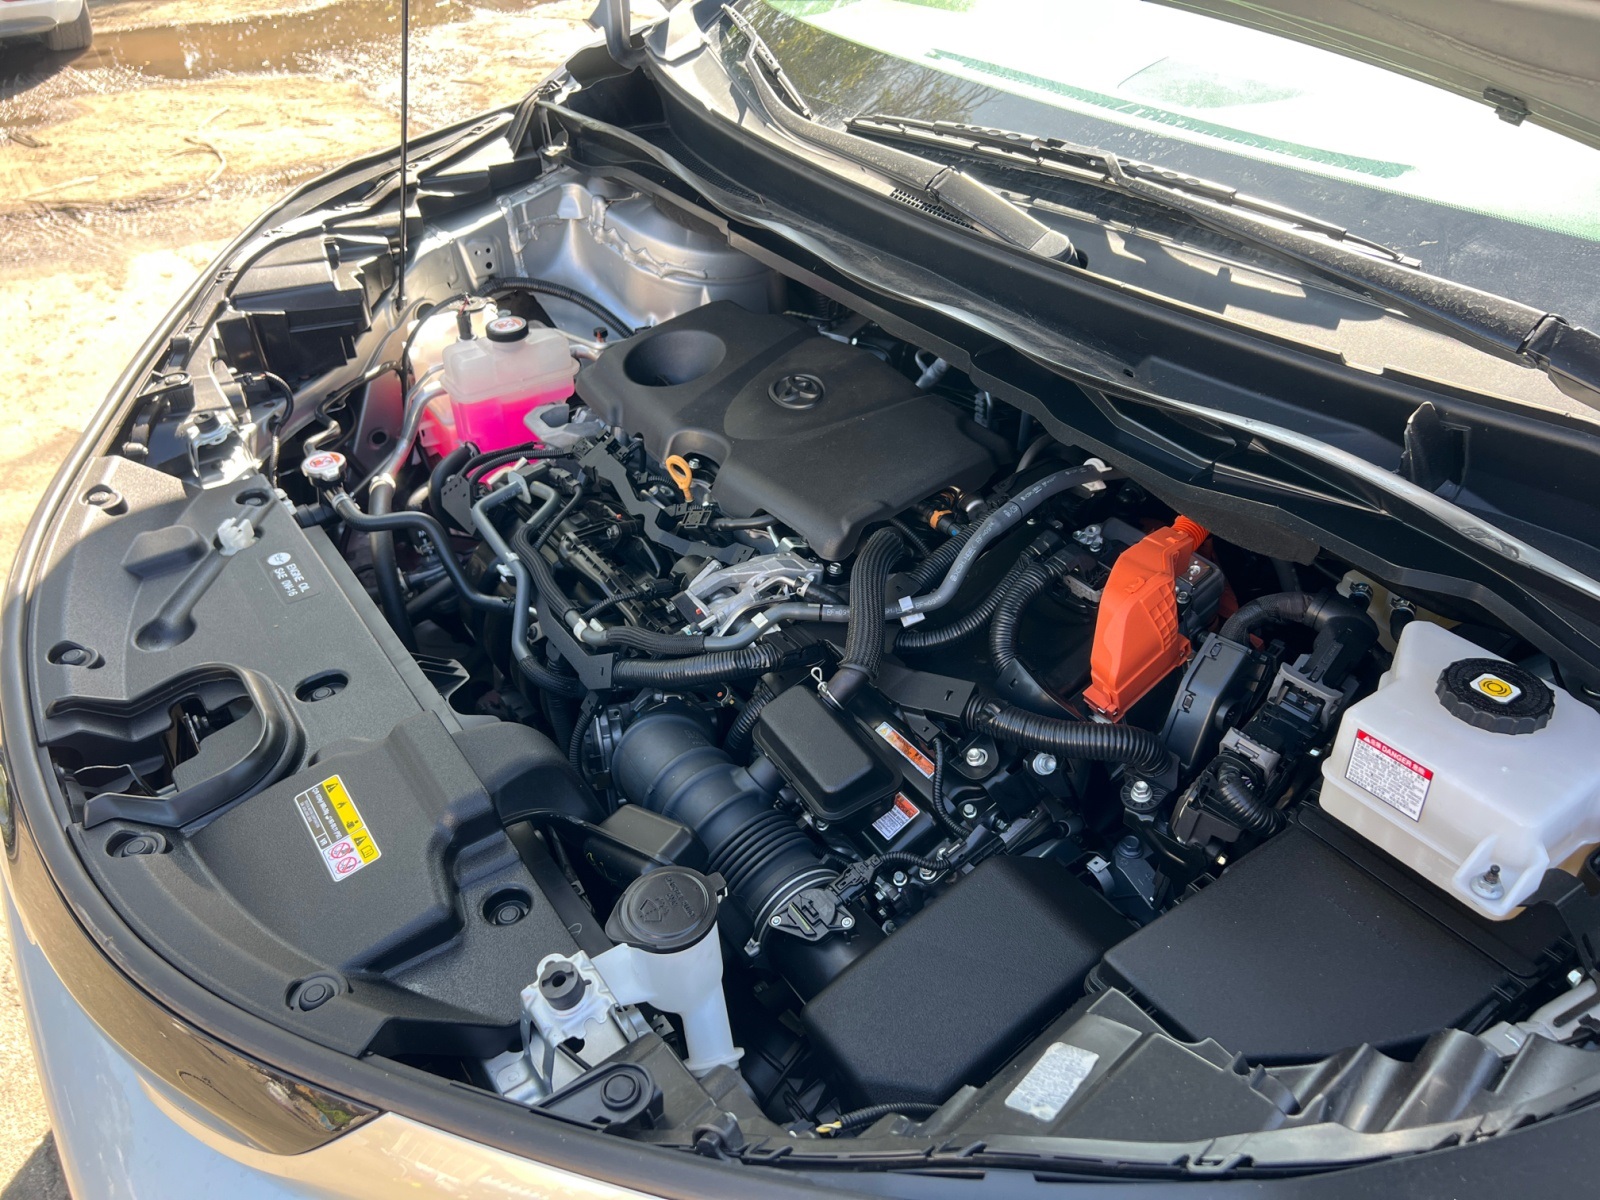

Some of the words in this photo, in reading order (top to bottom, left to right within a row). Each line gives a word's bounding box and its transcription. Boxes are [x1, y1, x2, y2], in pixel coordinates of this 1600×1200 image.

[273, 567, 288, 580] SAE
[281, 580, 298, 597] 0W-16
[286, 563, 305, 582] ENGINE
[298, 582, 310, 593] OIL
[1382, 745, 1413, 767] DANGER
